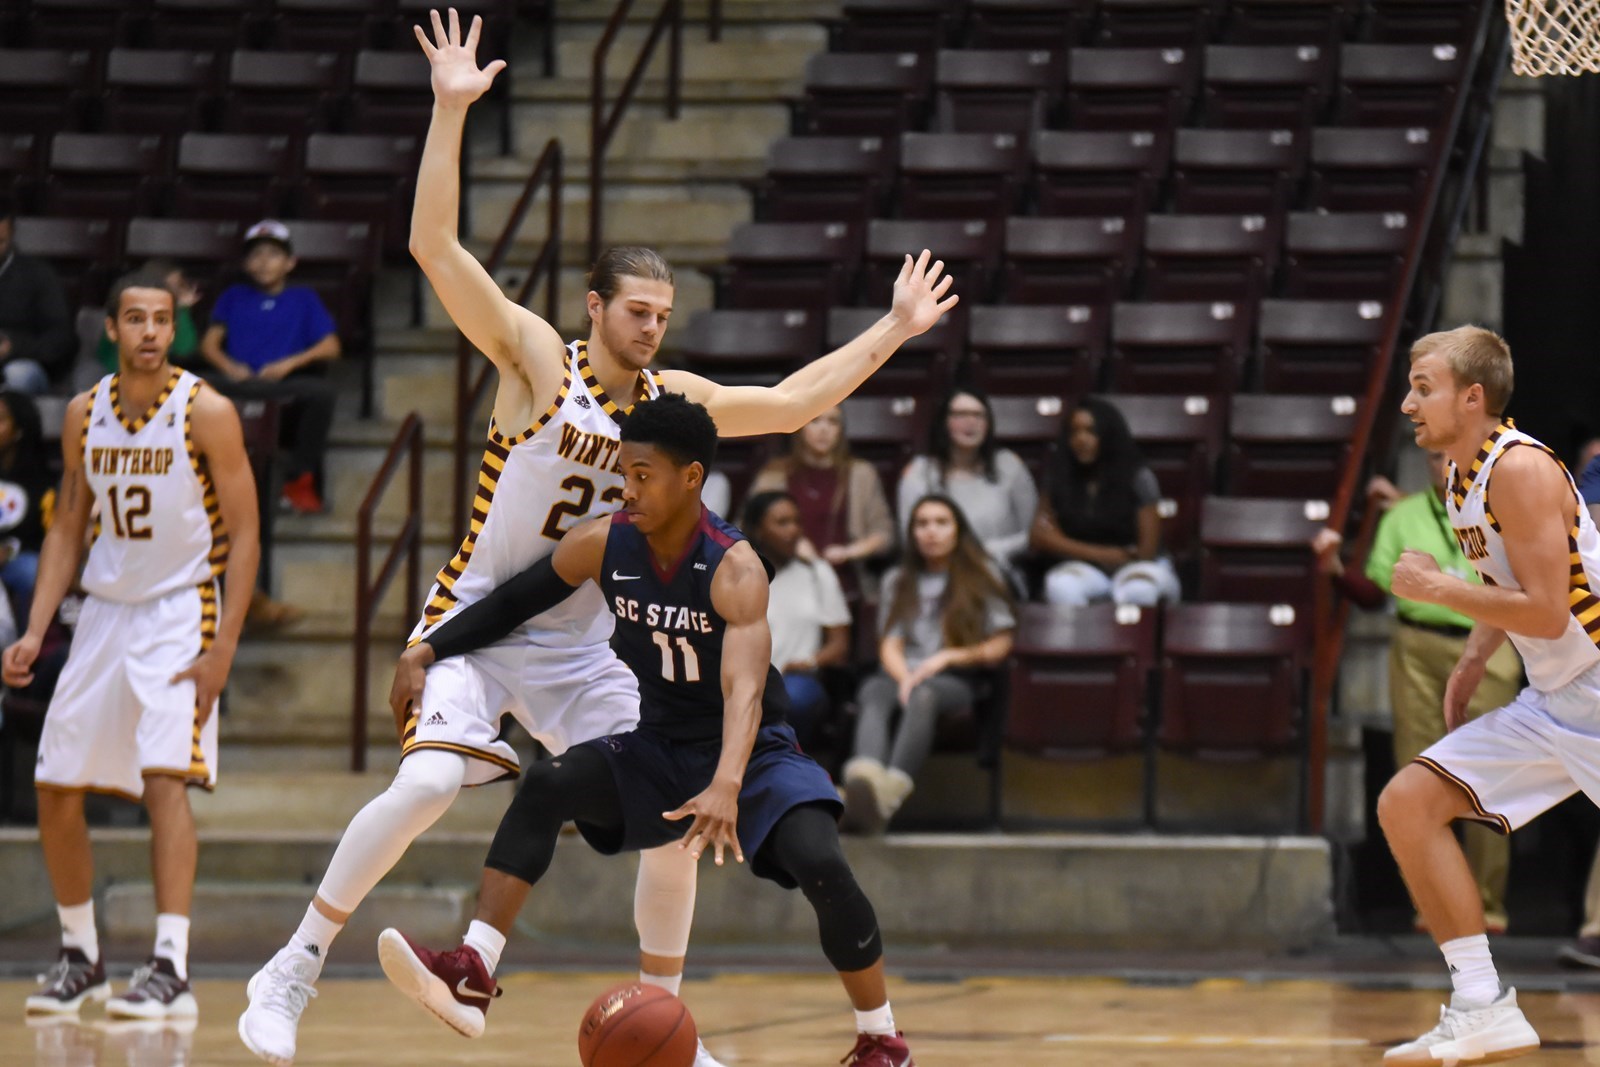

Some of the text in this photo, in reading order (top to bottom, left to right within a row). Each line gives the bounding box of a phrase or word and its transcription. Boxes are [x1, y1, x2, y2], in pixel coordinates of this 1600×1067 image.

[91, 447, 174, 475] WINTHROP
[557, 421, 622, 475] WINT
[107, 485, 153, 540] 12
[614, 595, 713, 634] SC STATE
[651, 630, 701, 683] 11
